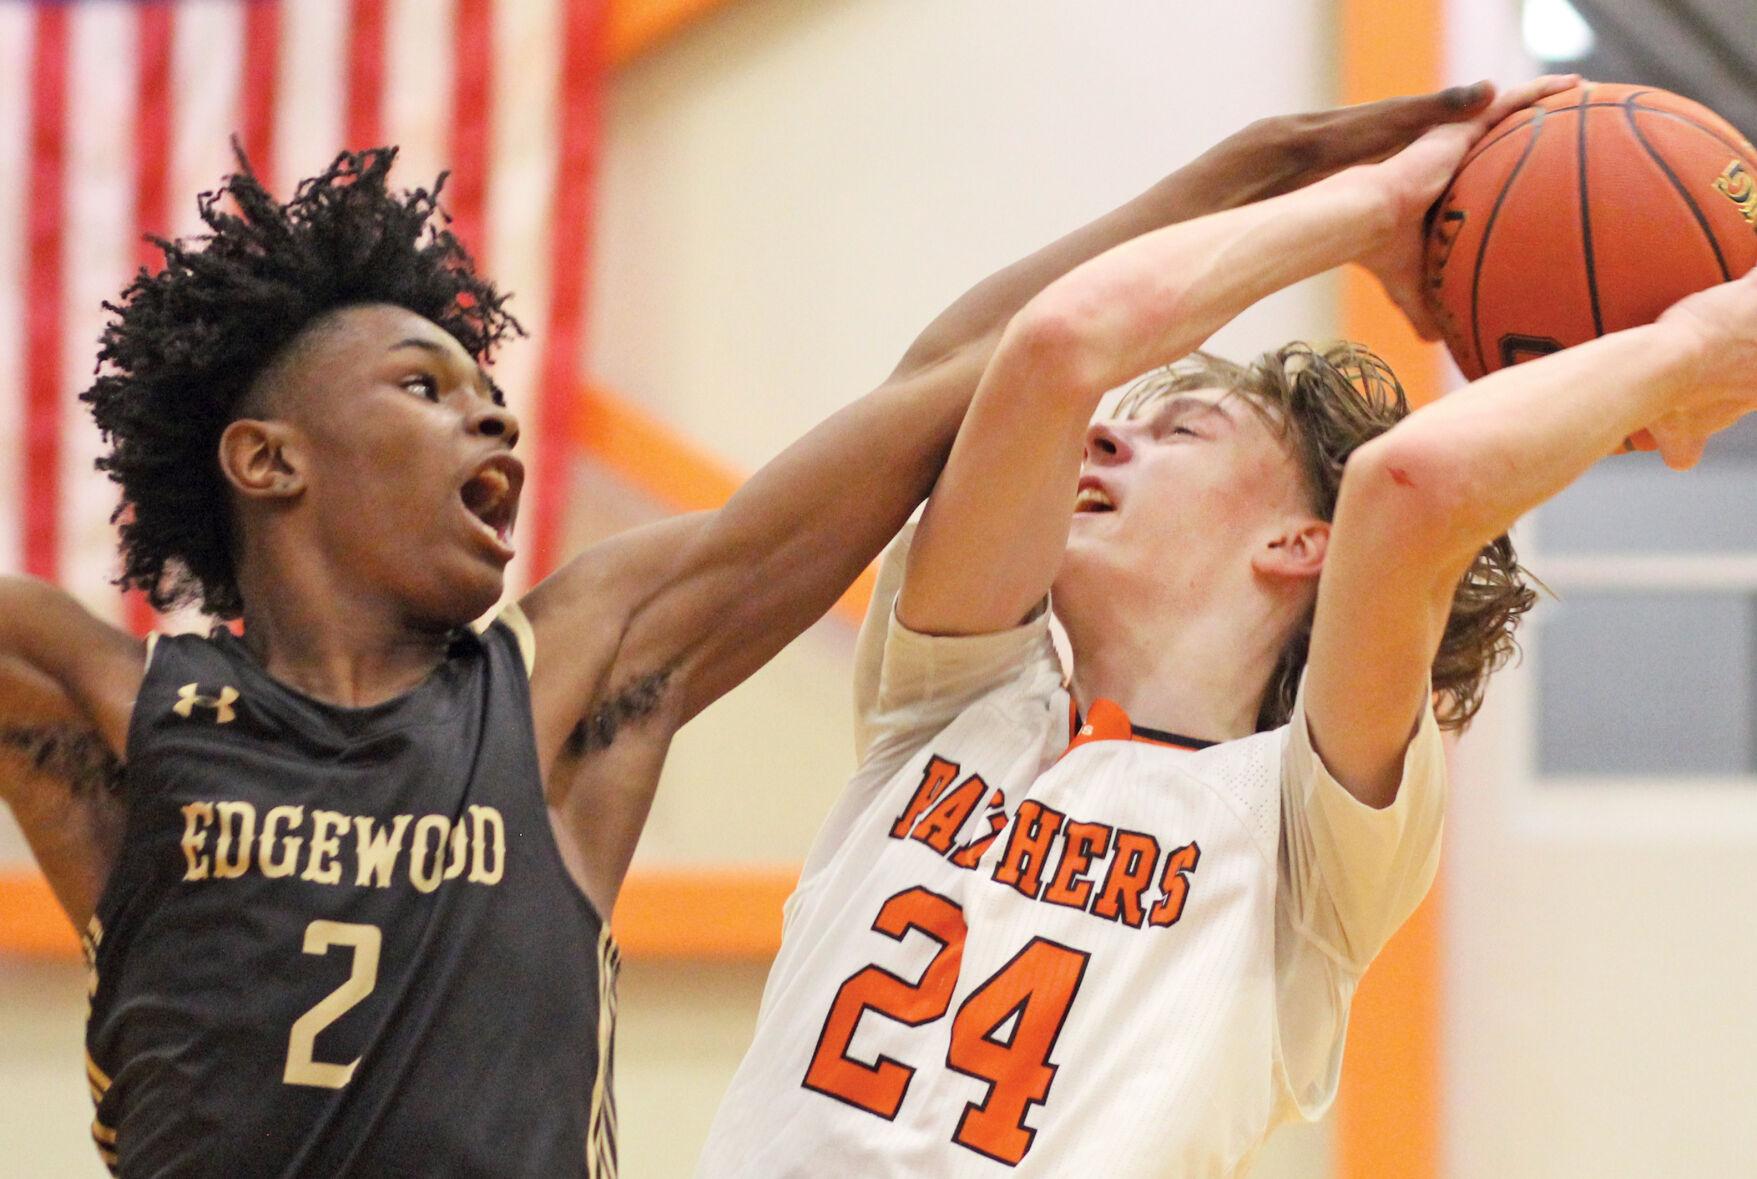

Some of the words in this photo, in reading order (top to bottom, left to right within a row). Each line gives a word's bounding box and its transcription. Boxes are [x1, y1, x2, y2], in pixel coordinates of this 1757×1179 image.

[888, 754, 1201, 930] PAHERS
[282, 919, 382, 1089] 2
[800, 885, 1092, 1168] 24
